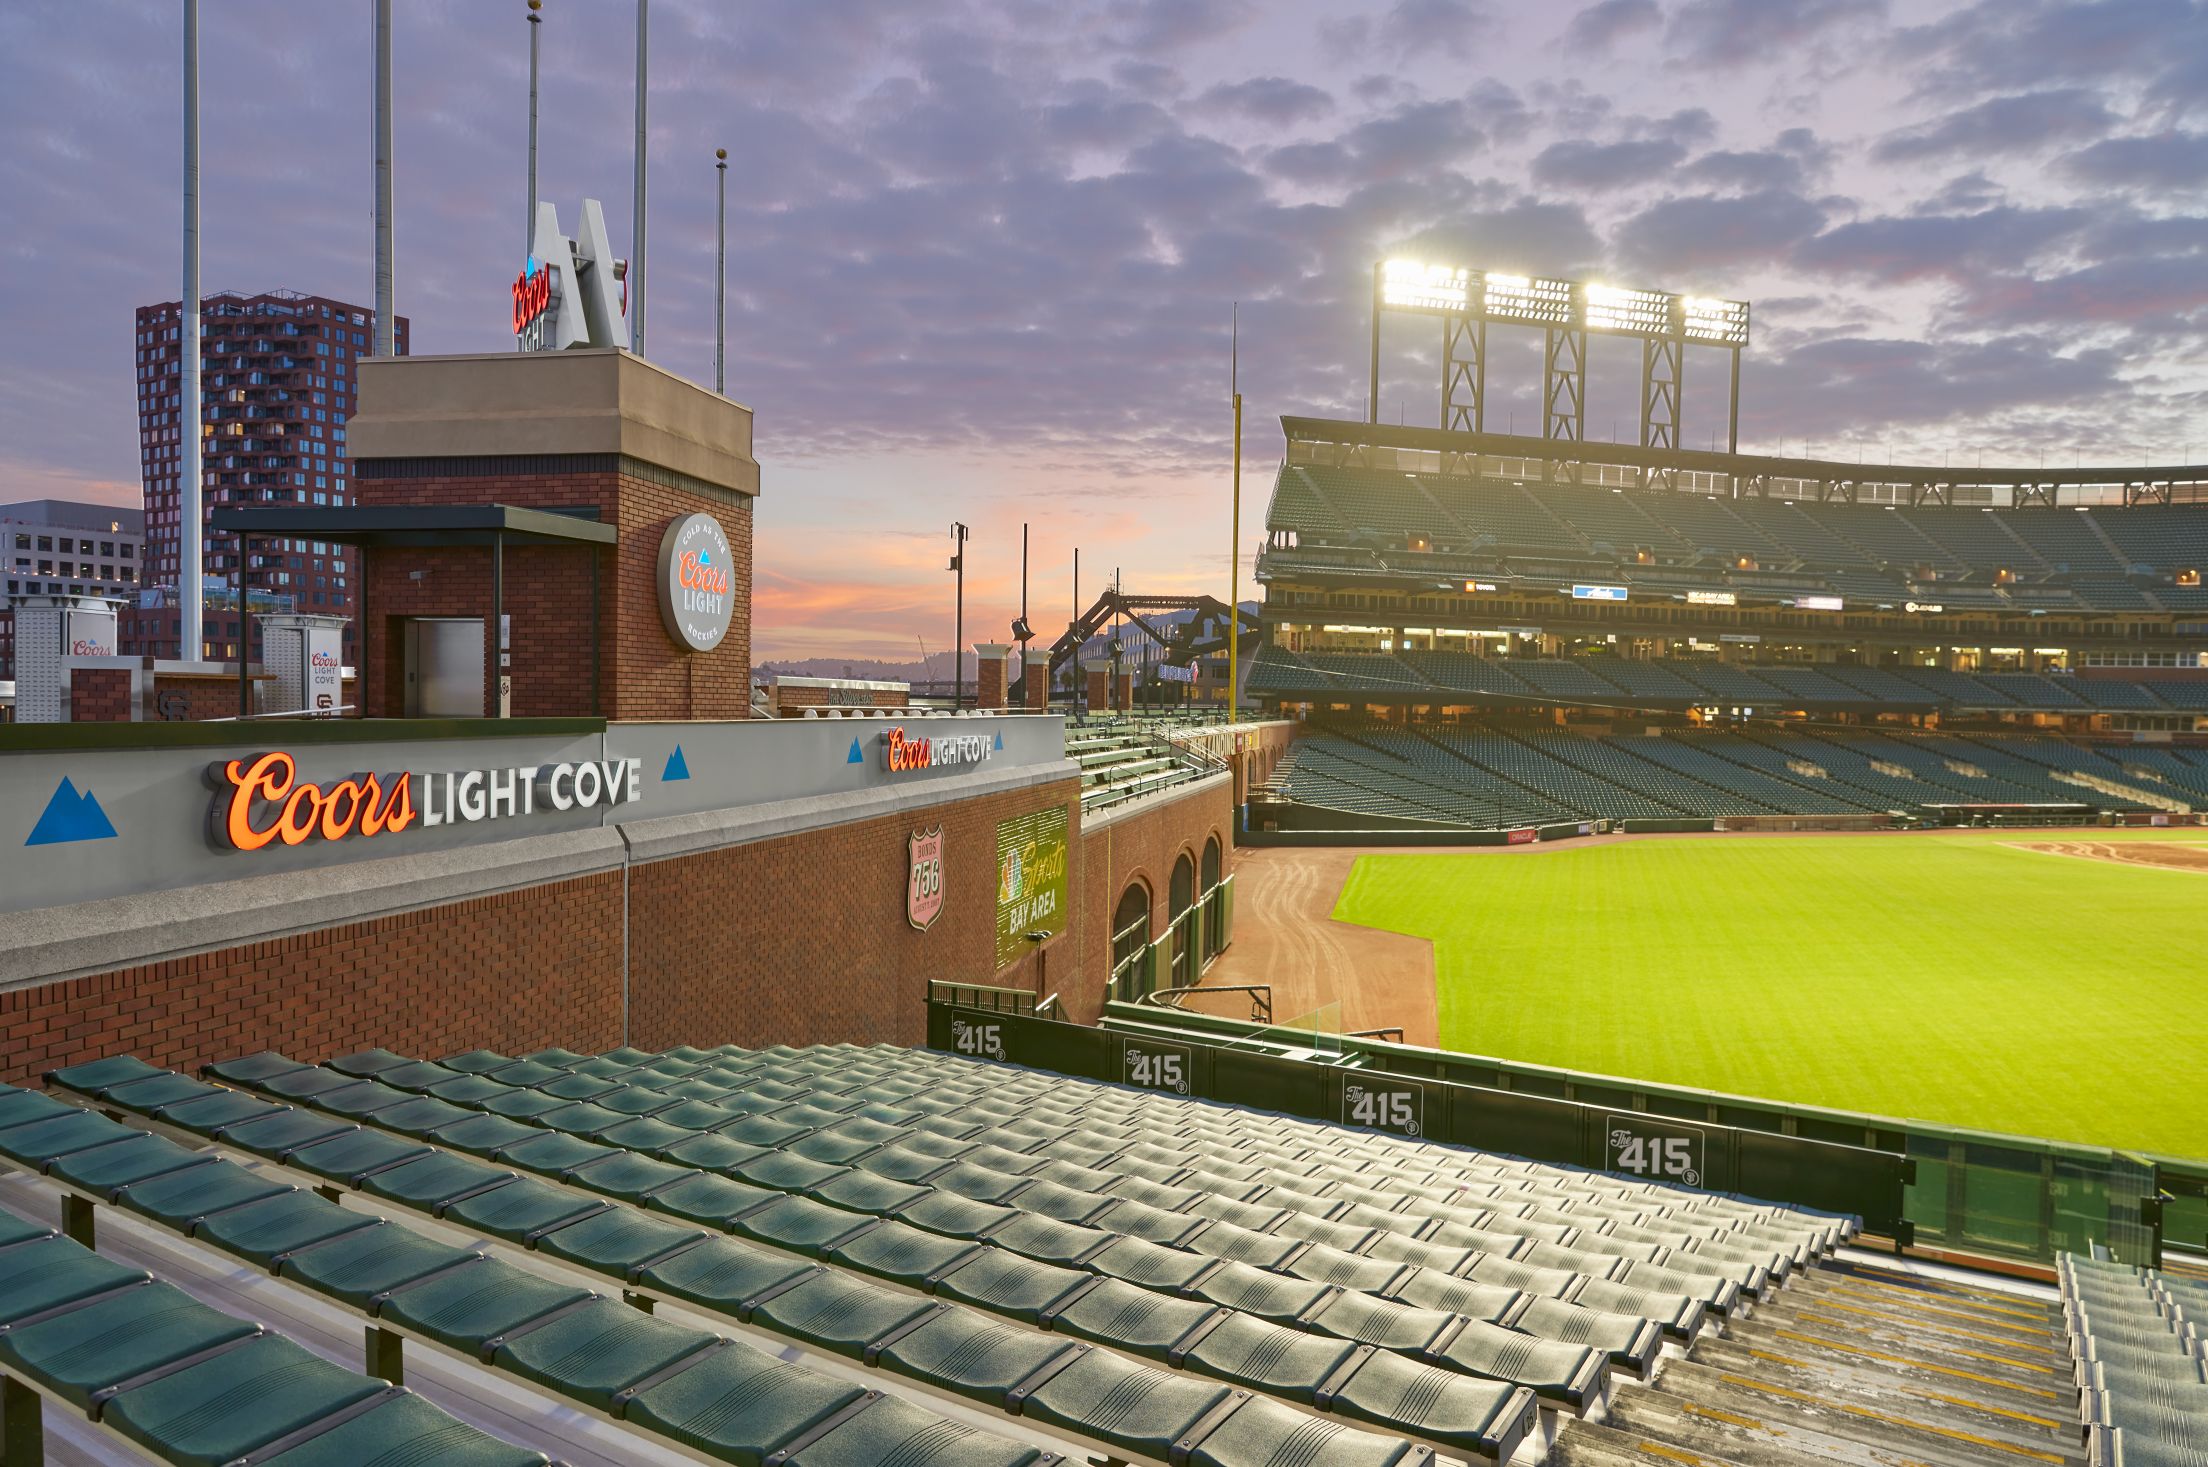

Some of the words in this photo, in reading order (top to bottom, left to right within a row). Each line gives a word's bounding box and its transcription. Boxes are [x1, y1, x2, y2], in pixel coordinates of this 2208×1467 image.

[512, 262, 551, 335] Coors
[682, 524, 700, 545] COLD
[703, 524, 712, 536] AS
[714, 533, 726, 554] THE
[679, 550, 728, 595] Coors
[684, 590, 723, 615] LIGHT
[688, 623, 718, 641] ROCKIES
[73, 640, 112, 656] Coors
[312, 653, 338, 667] Coors
[314, 667, 335, 675] LIGHT
[315, 676, 335, 685] COVE
[888, 726, 931, 773] Coors
[931, 737, 961, 766] LIGHT
[965, 735, 992, 763] COVE
[225, 750, 417, 851] Coors
[423, 766, 539, 827] LIGHT
[550, 757, 642, 811] COVE
[917, 842, 937, 858] BONDS
[913, 858, 940, 902] 756
[1021, 839, 1067, 897] Sports
[1010, 901, 1029, 935] BAY
[1030, 888, 1056, 923] AREA
[957, 1025, 1001, 1054] 415
[1131, 1055, 1182, 1086] 415
[1345, 1085, 1364, 1103] The
[1351, 1092, 1413, 1126] 415
[1609, 1130, 1633, 1149] The
[1617, 1137, 1692, 1175] 415
